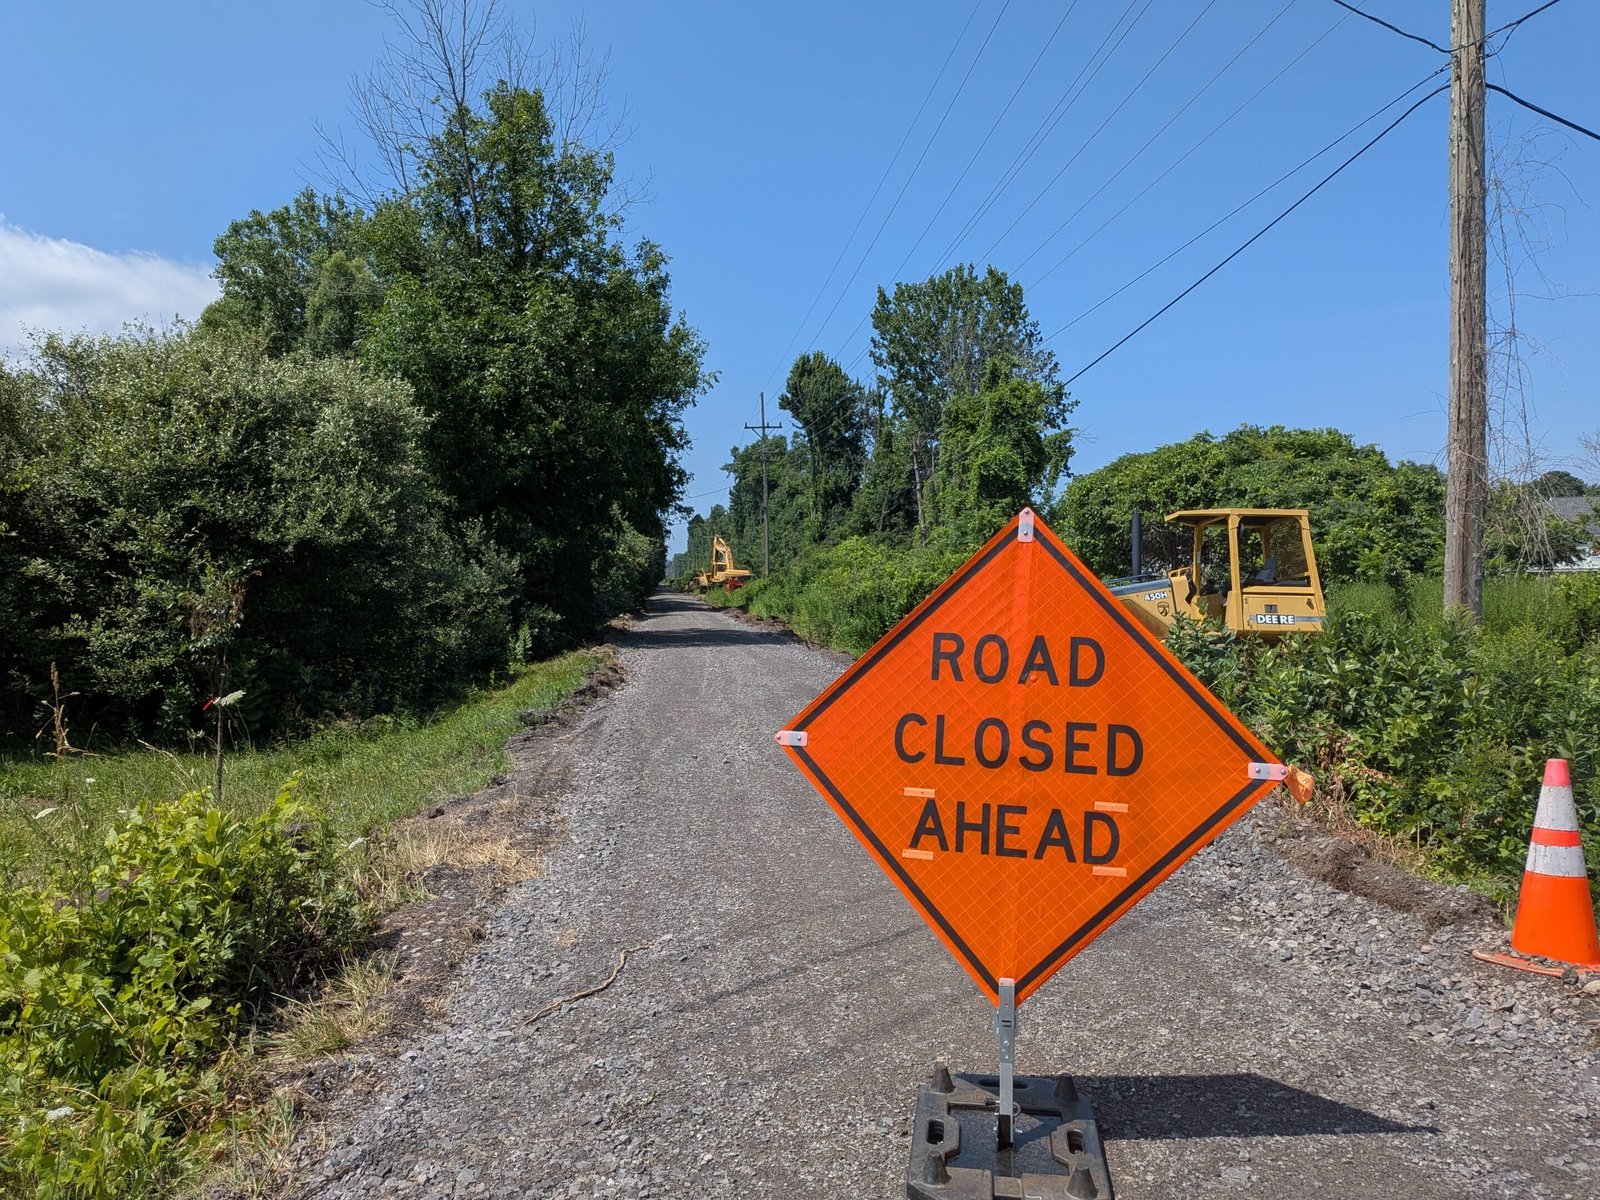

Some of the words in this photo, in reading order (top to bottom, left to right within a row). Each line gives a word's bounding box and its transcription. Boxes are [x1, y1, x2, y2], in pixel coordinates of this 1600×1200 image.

[1144, 591, 1168, 601] 450H
[1256, 614, 1295, 624] DEERE
[930, 632, 1106, 687] ROAD
[894, 712, 1144, 777] CLOSED
[908, 797, 1120, 865] AHEAD
